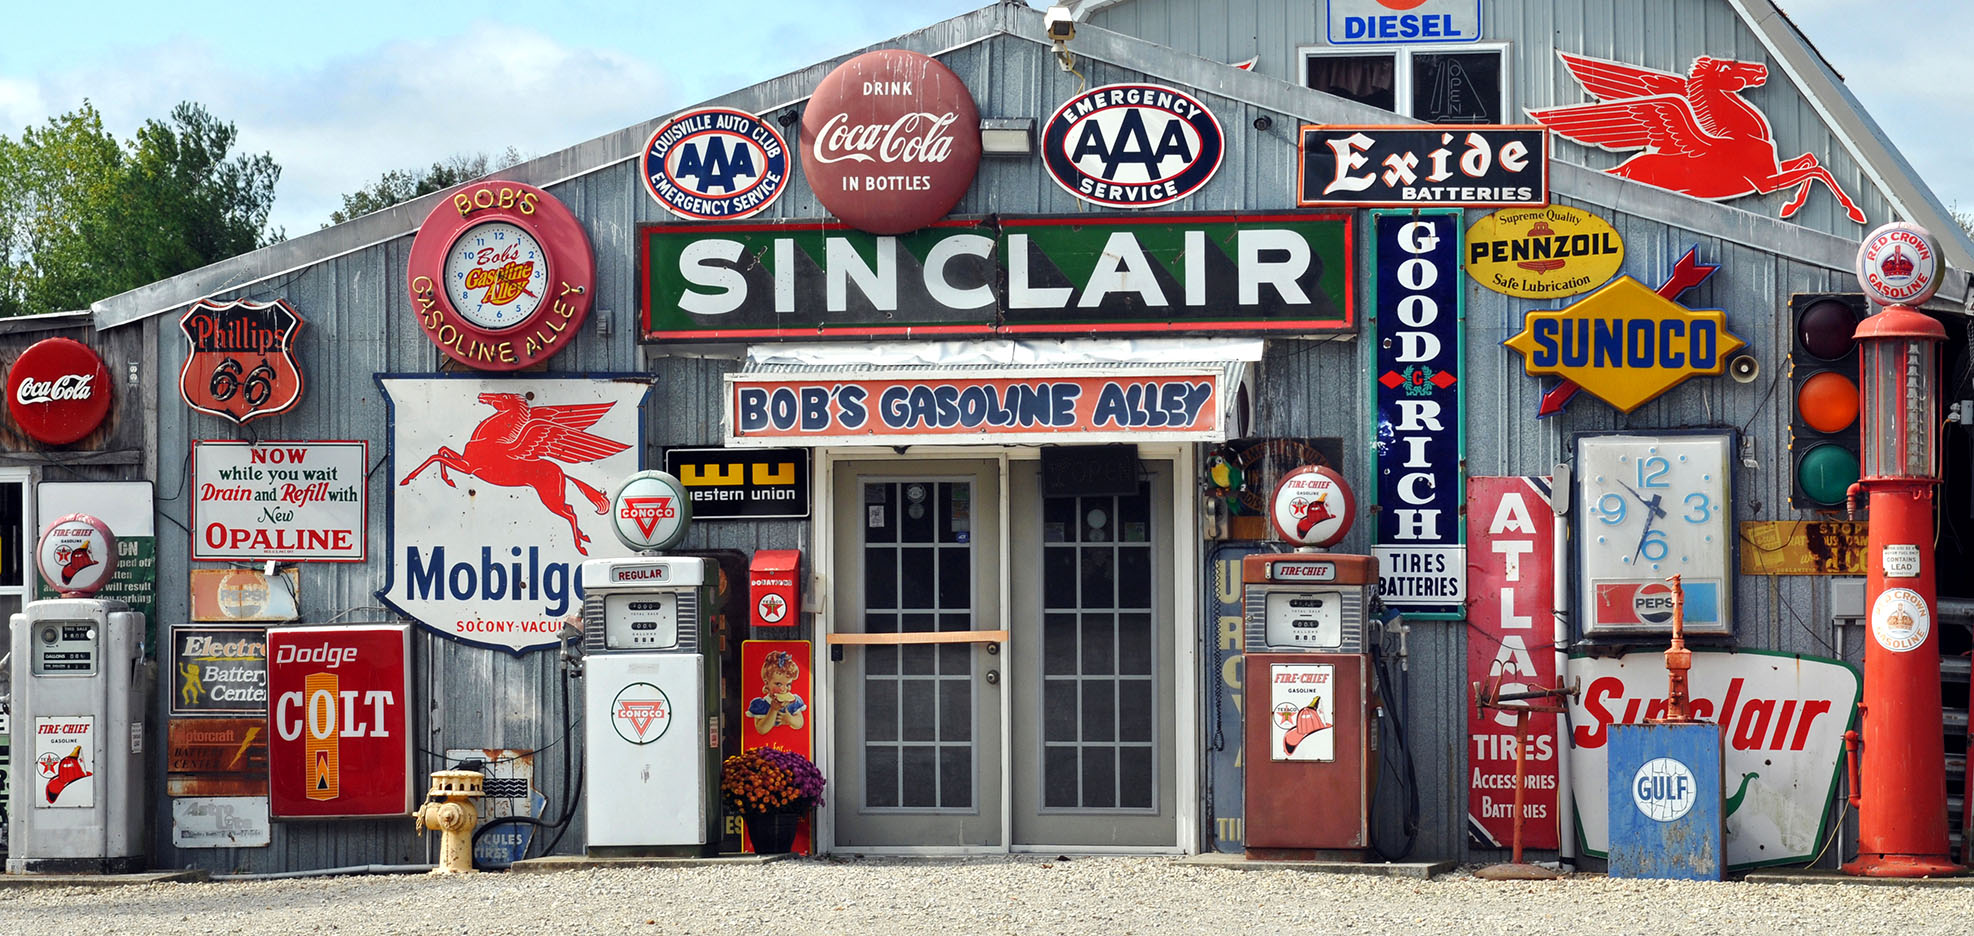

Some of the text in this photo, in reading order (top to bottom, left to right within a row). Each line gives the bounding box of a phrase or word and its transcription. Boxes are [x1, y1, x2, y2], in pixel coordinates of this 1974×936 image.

[1345, 14, 1461, 39] DIESEL
[863, 82, 913, 96] DRINK
[1449, 65, 1462, 114] OPEN
[1063, 90, 1202, 125] EMERGENCY
[650, 113, 782, 159] LOUISVILLE AUTO CLUB
[813, 112, 960, 164] Coca-Cola
[1072, 108, 1193, 181] AAA
[676, 136, 757, 193] AAA
[1323, 132, 1529, 196] Exide
[651, 170, 782, 215] EMERGENCY SERVICE
[842, 175, 931, 191] IN BOTTLES
[1079, 178, 1179, 201] SERVICE
[1402, 186, 1532, 200] BATTERIES
[454, 188, 539, 215] BOB'S
[1499, 208, 1582, 226] Supreme Quality
[476, 238, 485, 246] 11
[494, 232, 504, 240] 12
[1868, 231, 1931, 261] RED CROWN
[464, 252, 474, 260] 10
[476, 243, 520, 266] Bob's
[528, 251, 535, 259] 2
[1470, 232, 1619, 265] PENNZOIL
[457, 272, 464, 280] 9
[465, 261, 535, 290] Gasoline
[677, 229, 1312, 315] SINCLAIR
[1492, 272, 1591, 293] Safe Lubrication
[462, 291, 468, 299] 8
[482, 281, 529, 306] Alley
[1868, 272, 1929, 299] GASOLINE
[477, 304, 483, 312] 7
[515, 305, 521, 313] 5
[412, 276, 583, 363] GASOLINE ALLEY
[190, 314, 285, 356] Phillips
[1532, 318, 1717, 370] SUNOCO
[209, 357, 276, 406] 66
[738, 381, 1214, 432] BOB'S GASOLINE ALLEY
[251, 448, 307, 464] NOW
[219, 466, 338, 484] while you wait
[1636, 457, 1670, 488] 12
[201, 482, 358, 507] Drain and Refill with
[752, 487, 795, 500] union
[1288, 481, 1332, 489] FIRE-CHIEF
[257, 507, 294, 524] New
[621, 508, 674, 518] CONOCO
[1596, 493, 1710, 525] 9 3
[53, 529, 94, 537] FIRE-CHIEF
[205, 522, 353, 550] OPALINE
[1642, 529, 1669, 561] 6
[1280, 566, 1328, 576] FIRE-CHIEF
[1390, 553, 1445, 573] TIRES
[406, 546, 585, 617] Mobilg
[618, 569, 662, 580] REGULAR
[105, 582, 151, 591] will result
[1379, 576, 1458, 597] BATTERIES
[1635, 598, 1673, 610] PEPS
[1894, 591, 1927, 617] CROWN
[456, 620, 563, 633] SOCONY-VACU
[277, 642, 357, 669] Dodge
[203, 666, 266, 686] Battery
[1274, 673, 1330, 683] FIRE-CHIEF
[276, 690, 394, 742] COLT
[620, 710, 663, 718] CONOCO
[38, 724, 90, 734] FIRE-CHIEF
[1473, 734, 1553, 761] TIRES
[1472, 767, 1555, 789] ACCESSRIES
[1637, 775, 1688, 800] GULF
[1482, 796, 1547, 818] BATTRIES
[482, 834, 523, 846] CULES
